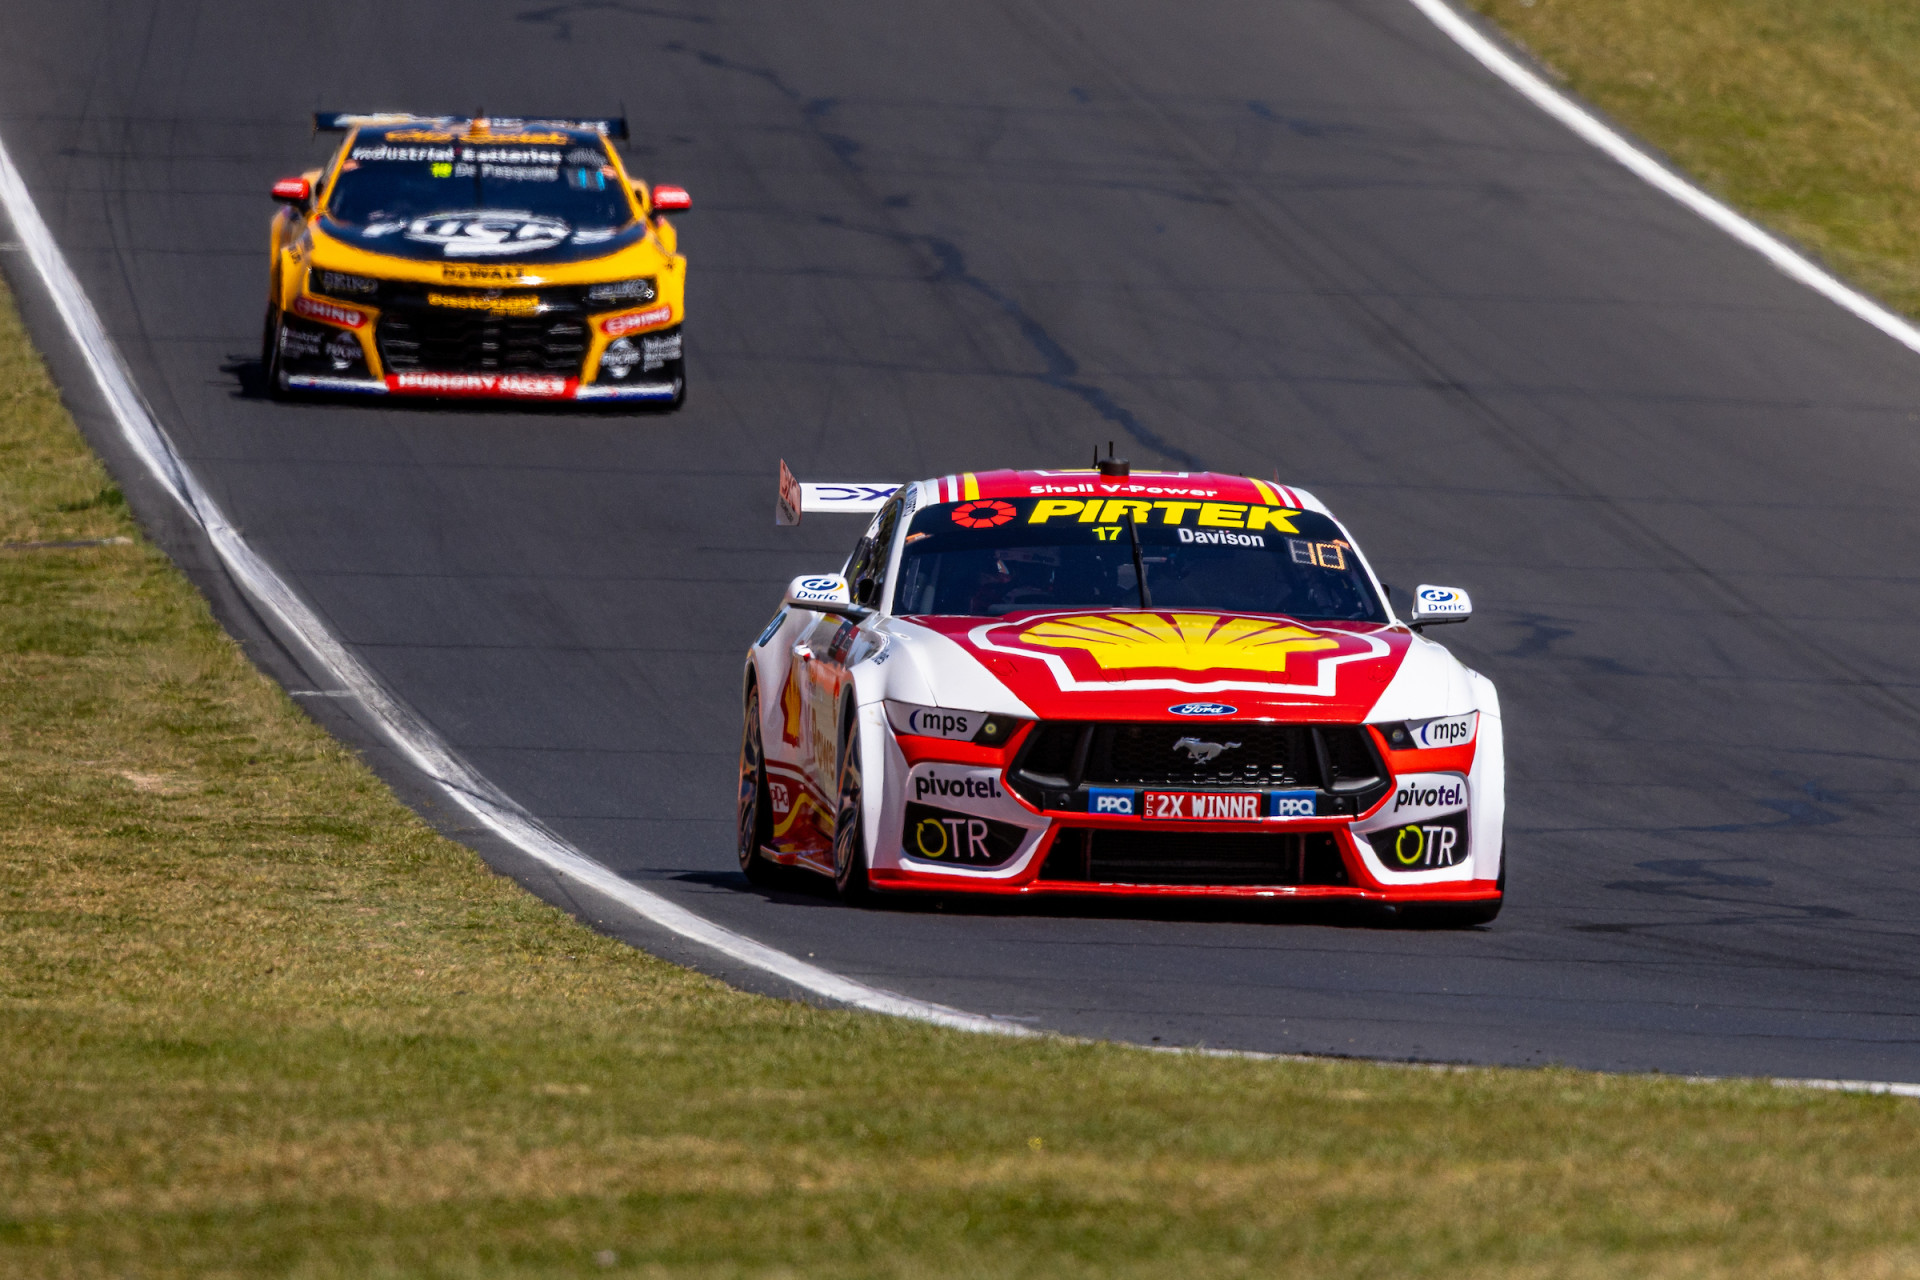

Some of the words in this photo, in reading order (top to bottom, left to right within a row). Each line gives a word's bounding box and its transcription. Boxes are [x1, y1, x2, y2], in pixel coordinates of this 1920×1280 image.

[352, 145, 454, 162] Industrial
[399, 373, 496, 390] HUNGRY
[815, 487, 899, 501] DX
[1029, 484, 1094, 495] Shell
[1100, 484, 1218, 498] V-Power
[1028, 500, 1302, 534] PIRTEK
[1091, 527, 1123, 541] 17
[1178, 528, 1265, 547] Davison
[796, 590, 838, 601] Doric
[1428, 603, 1466, 612] Doric
[1181, 703, 1223, 715] Ford
[923, 713, 968, 736] mps
[1433, 720, 1467, 744] mps
[915, 770, 1002, 800] pivotel.
[1097, 796, 1132, 813] PPQ
[1157, 794, 1185, 817] 2X
[1192, 794, 1258, 818] WINNR
[1394, 782, 1463, 813] pivotel.
[1279, 798, 1314, 815] PPQ
[917, 818, 990, 858] OTR
[1396, 825, 1457, 866] OTR
